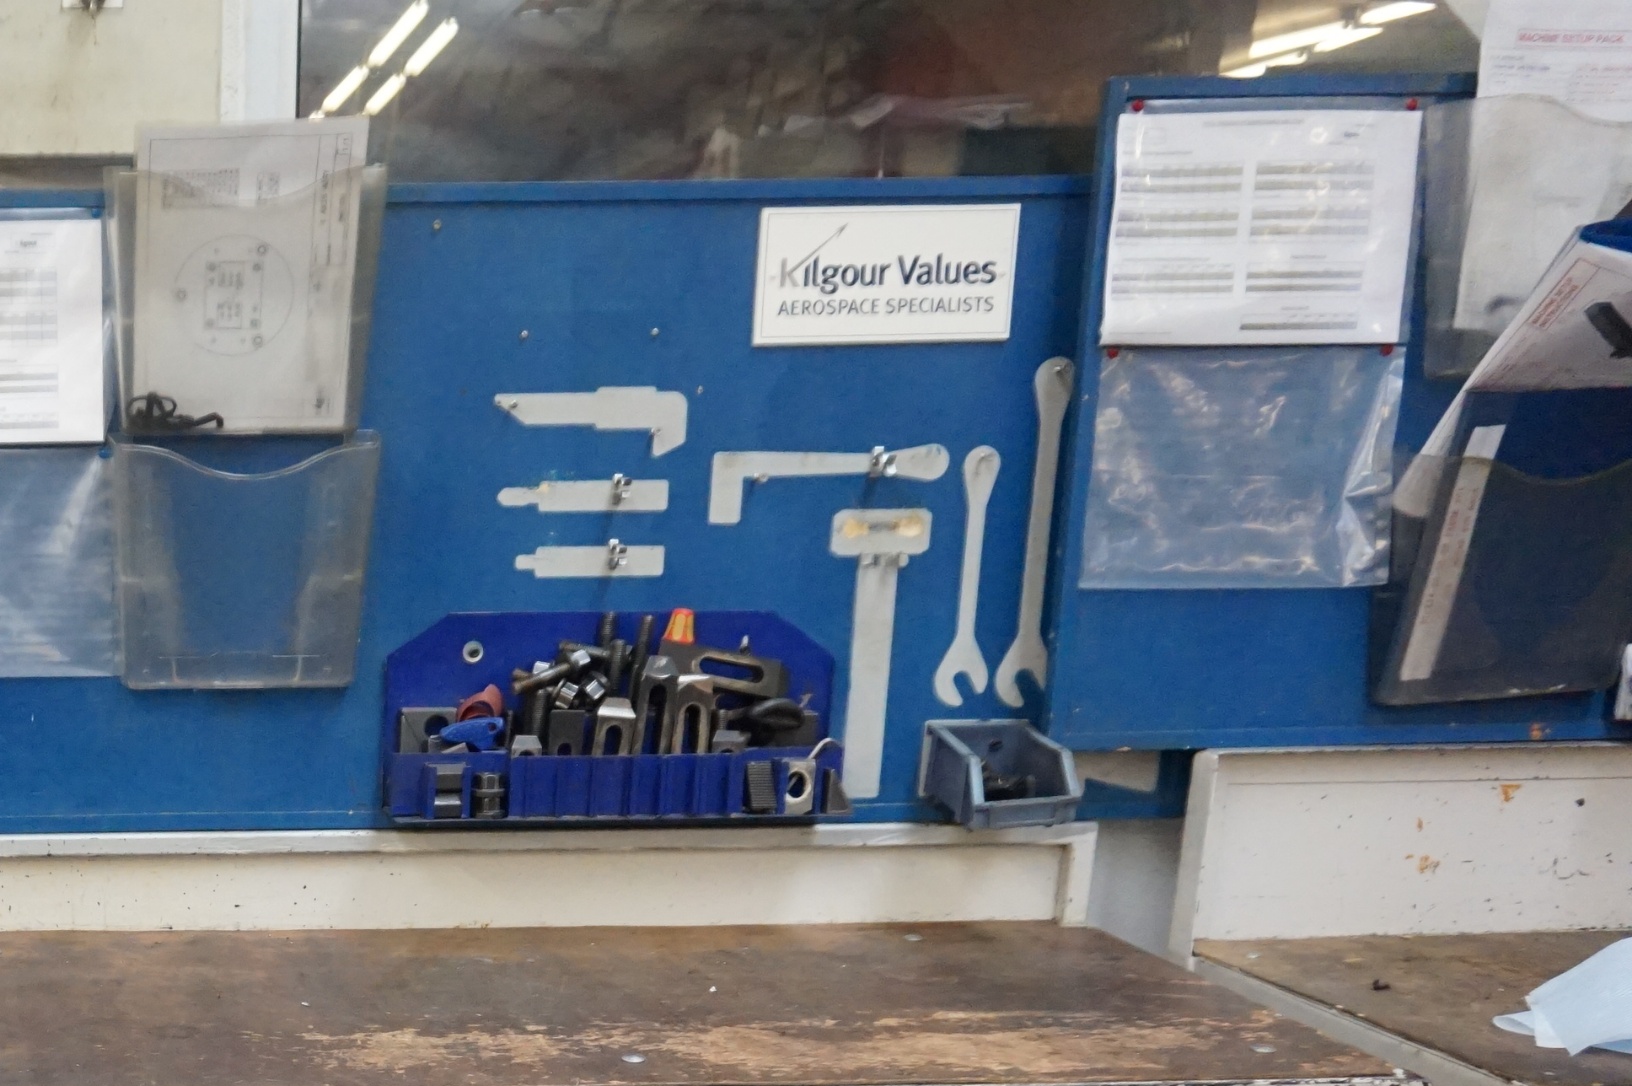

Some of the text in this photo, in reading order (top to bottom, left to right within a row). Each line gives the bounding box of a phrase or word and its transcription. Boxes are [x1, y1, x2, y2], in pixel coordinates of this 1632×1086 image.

[779, 253, 997, 295] Kilgour Values
[777, 296, 994, 316] AEROSPACE SPECIALISTS
